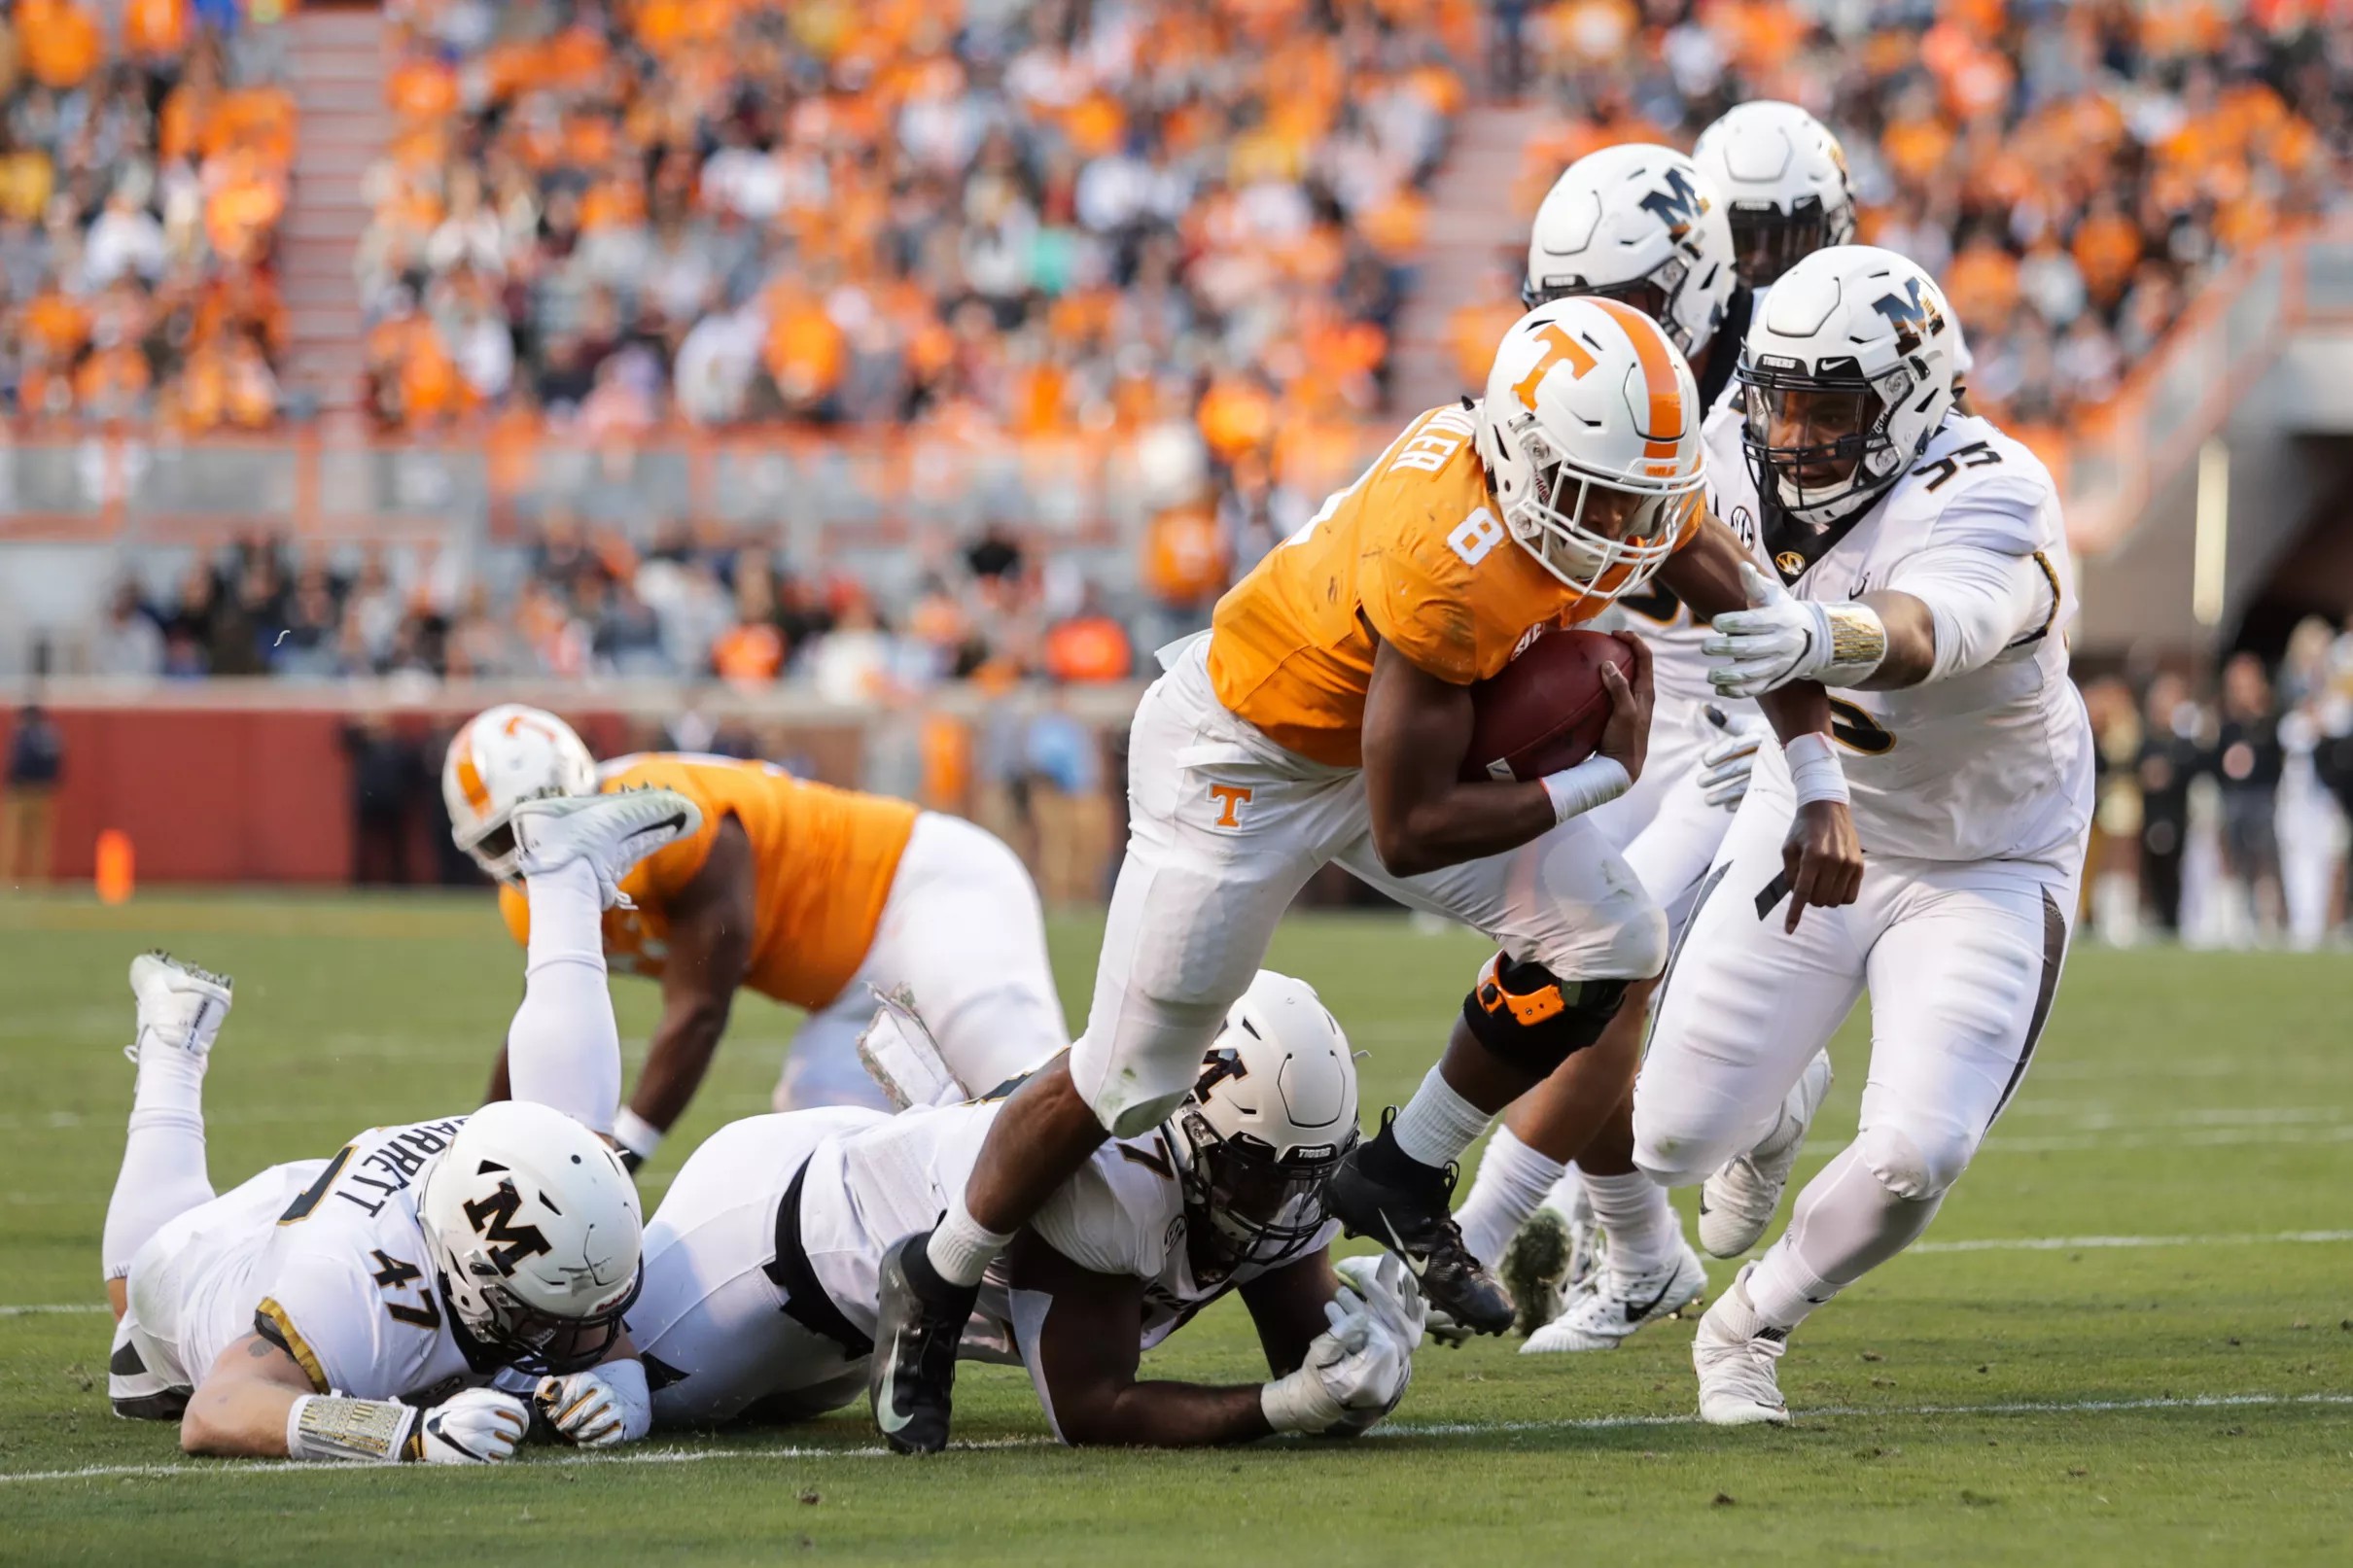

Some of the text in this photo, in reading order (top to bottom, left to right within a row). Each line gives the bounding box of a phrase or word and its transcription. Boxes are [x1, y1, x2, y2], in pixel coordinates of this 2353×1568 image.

[1510, 323, 1598, 413] T
[1446, 506, 1504, 566] 8
[1211, 783, 1252, 828] T
[334, 1118, 469, 1219] ARRETT
[462, 1176, 553, 1279] M
[369, 1248, 441, 1331] 47
